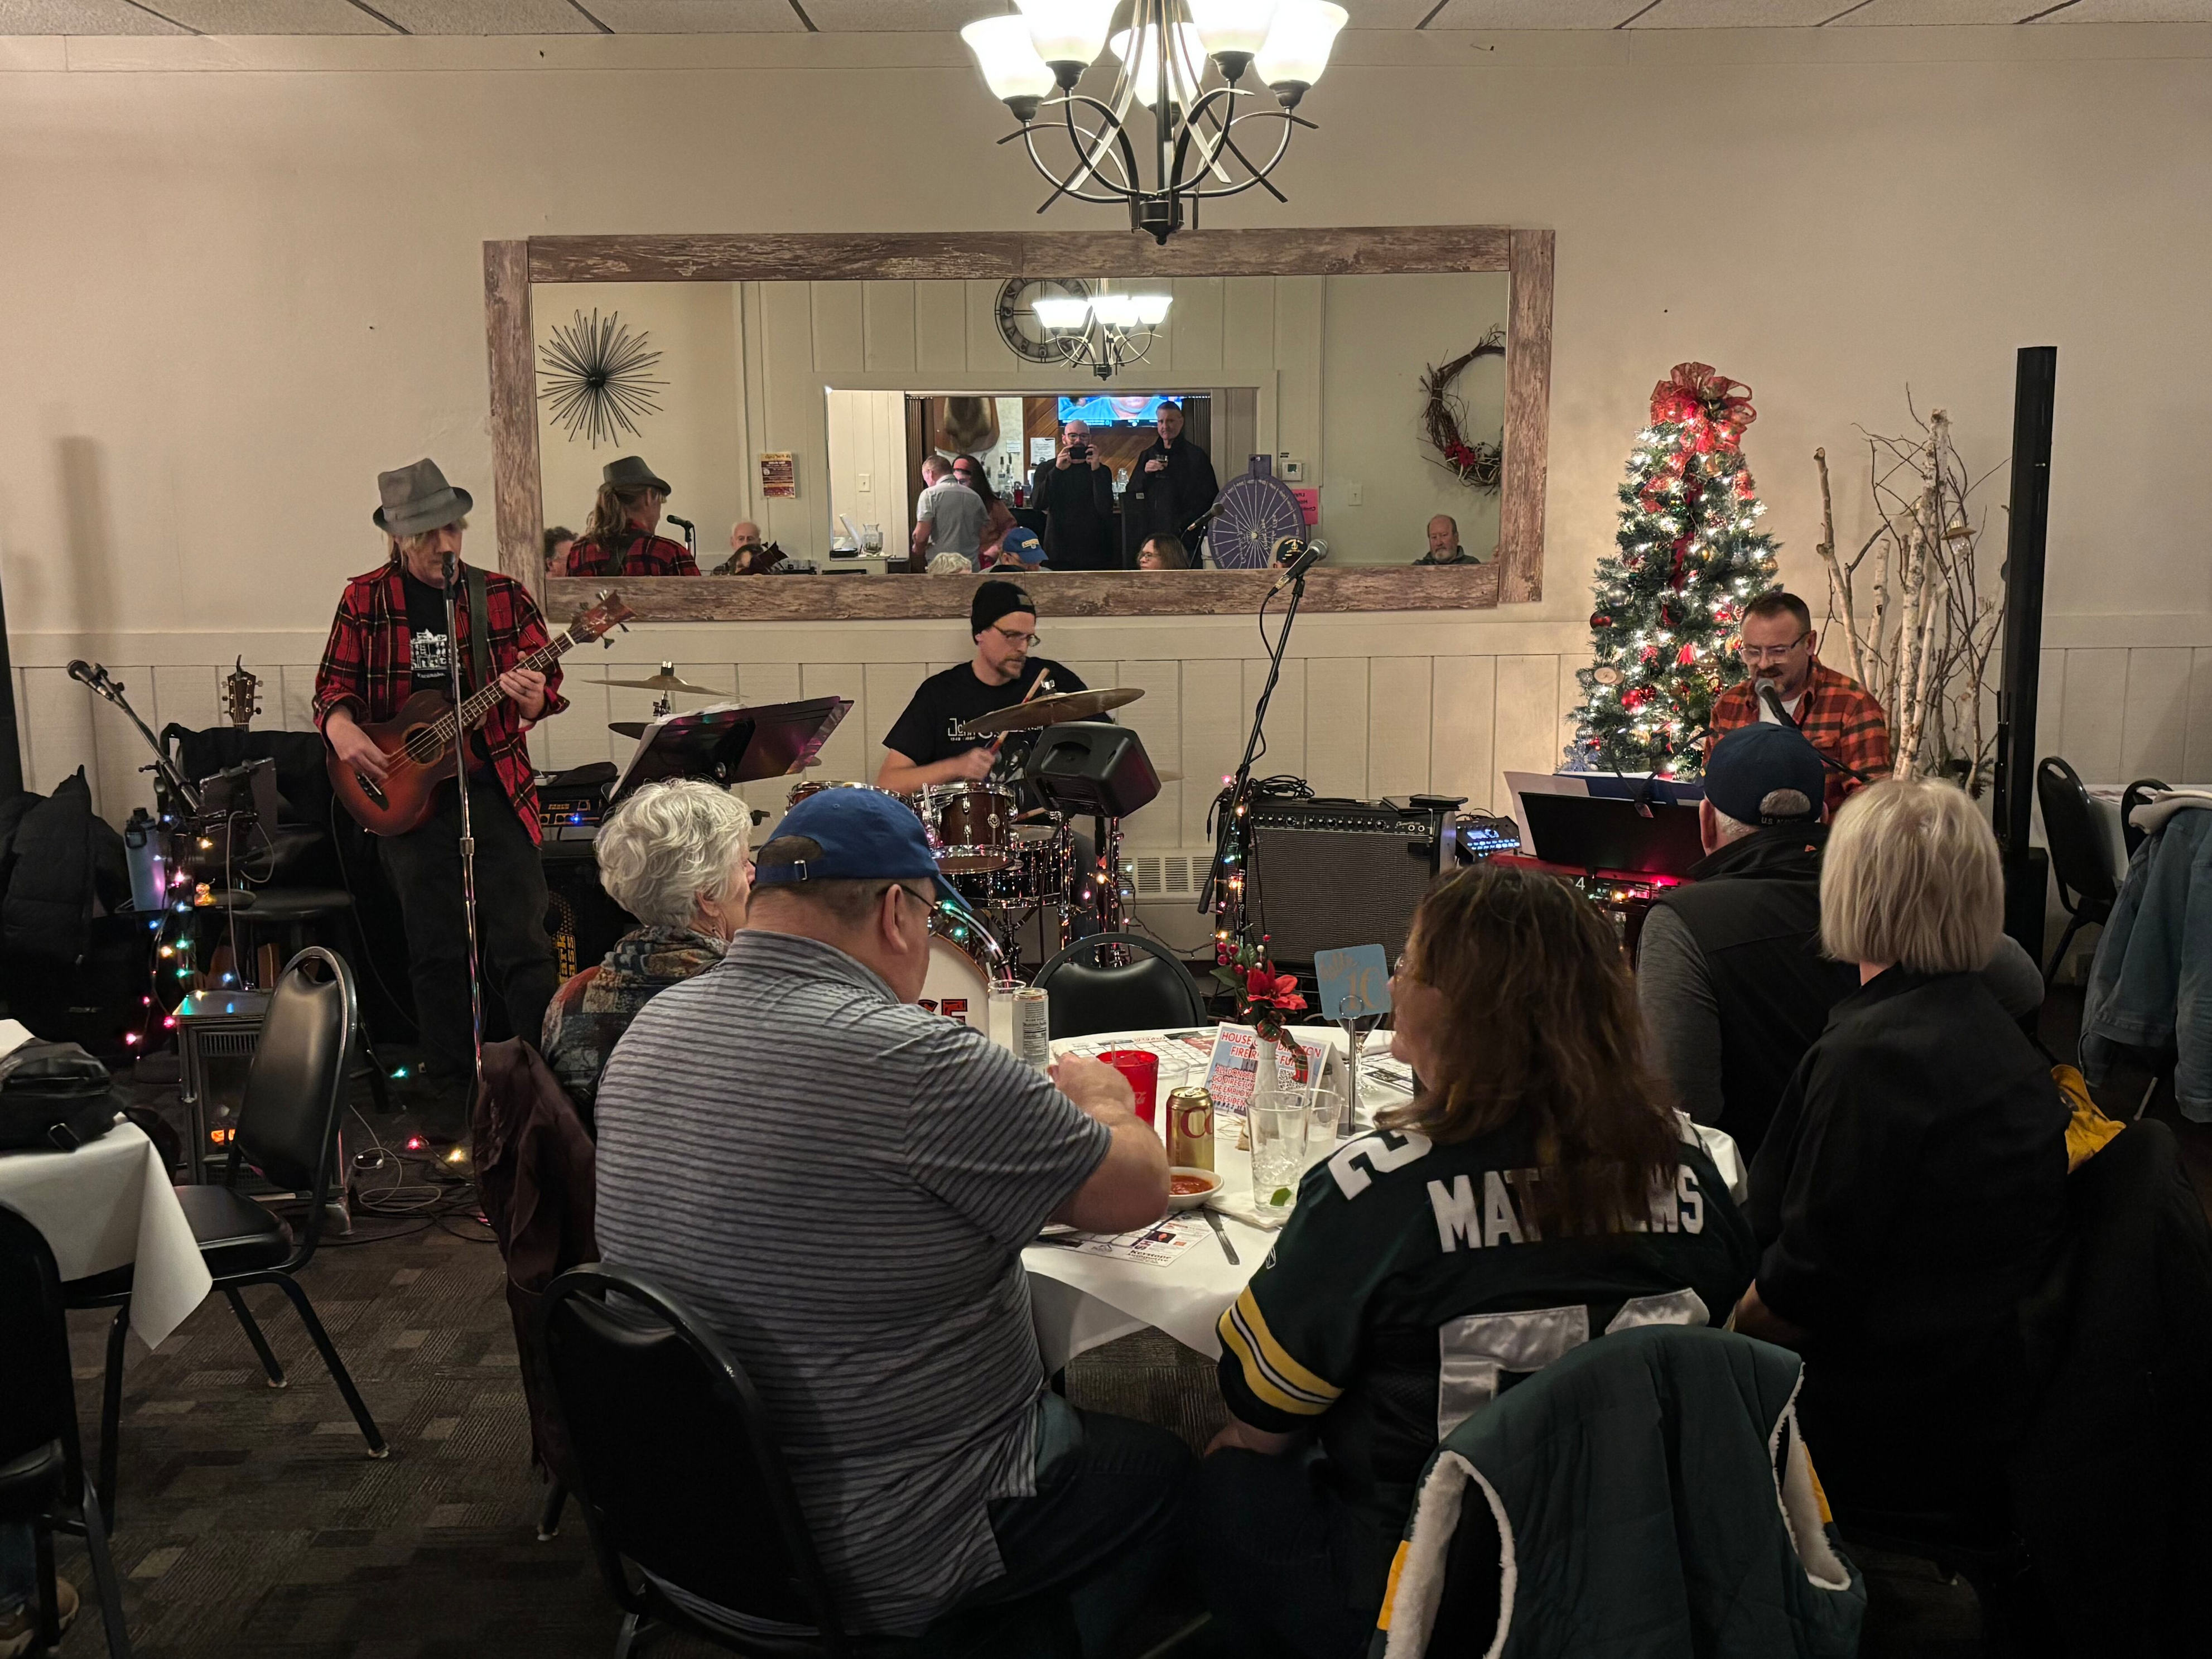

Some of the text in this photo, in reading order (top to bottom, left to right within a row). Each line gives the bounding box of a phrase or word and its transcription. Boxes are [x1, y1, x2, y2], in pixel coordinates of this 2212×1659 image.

[1575, 876, 1585, 891] 4
[1345, 966, 1385, 1011] 10
[1221, 1031, 1253, 1045] HOUSE
[1230, 1046, 1250, 1058] FIRE
[1215, 1065, 1227, 1074] ALL
[1211, 1083, 1222, 1092] THE
[1212, 1074, 1255, 1089] GO DIRECTLY
[1327, 1129, 1433, 1201] 2
